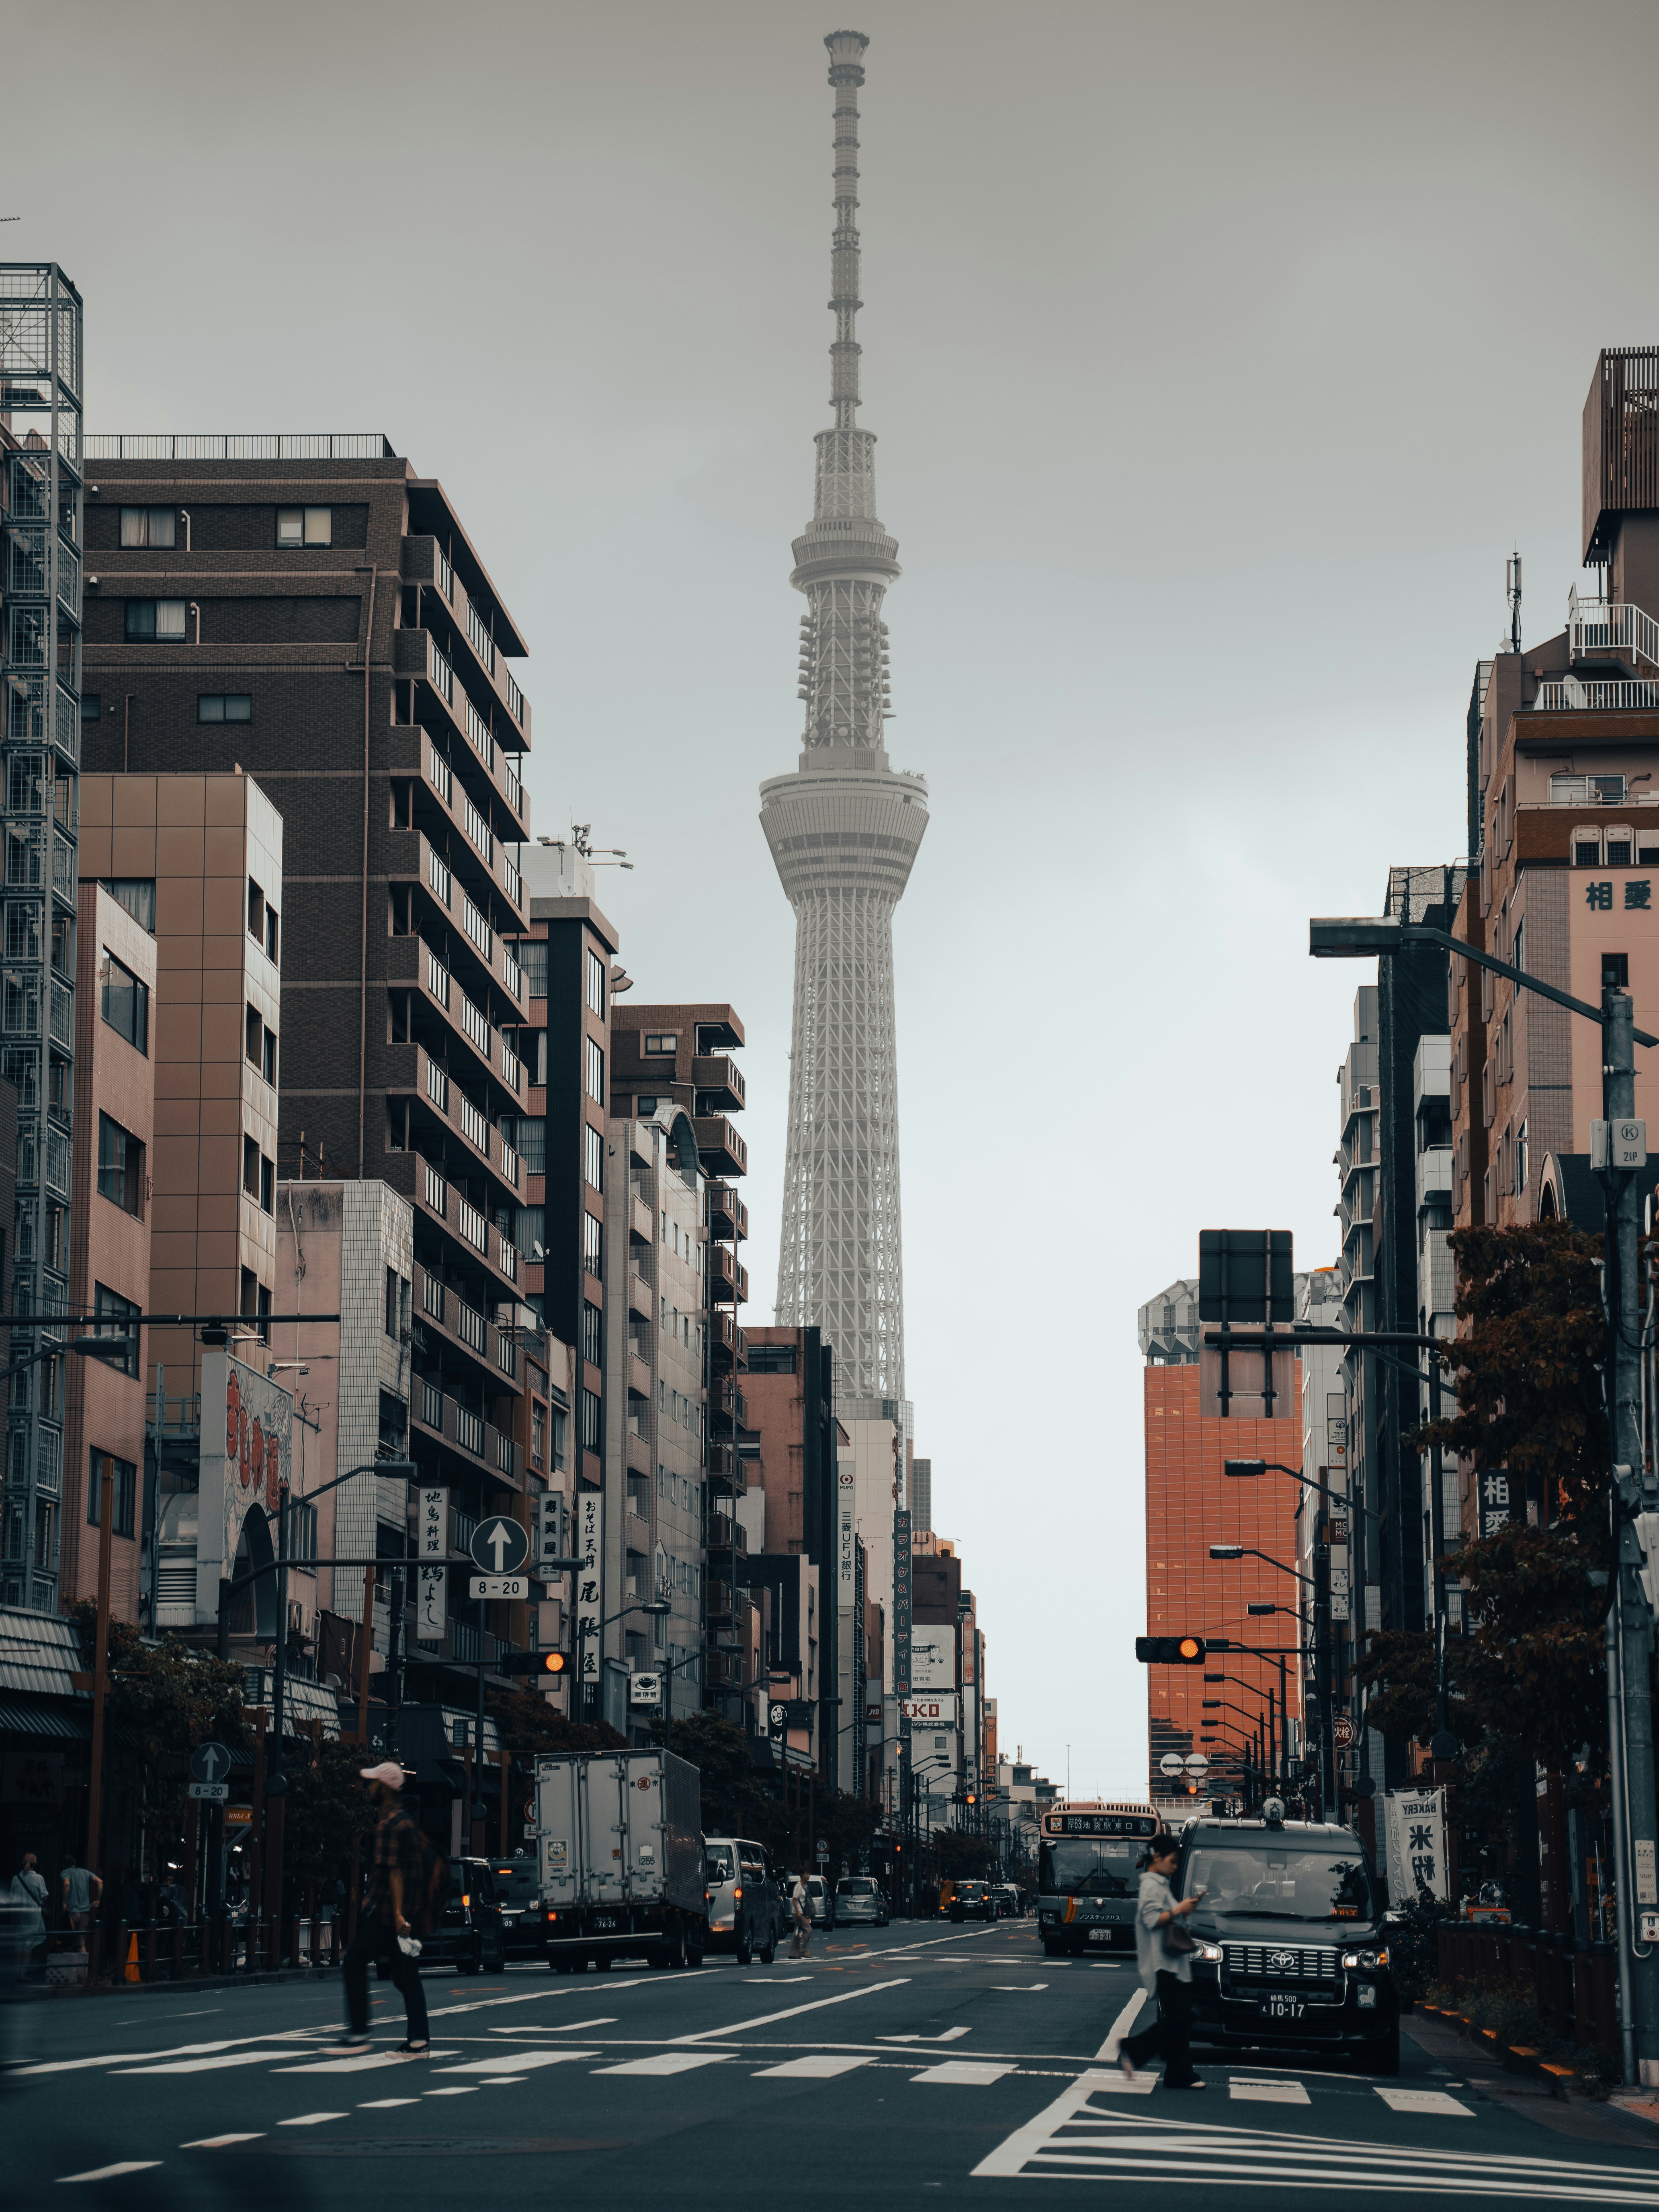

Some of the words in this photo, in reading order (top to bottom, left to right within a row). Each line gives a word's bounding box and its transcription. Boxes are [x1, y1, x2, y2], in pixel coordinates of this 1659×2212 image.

[1586, 880, 1651, 911] 相愛
[227, 1369, 289, 1523] すしや通
[842, 1512, 851, 1581] 三菱UFJ銀行
[1270, 1802, 1280, 1819] 大和
[639, 1858, 655, 1866] 1255
[1271, 2003, 1305, 2017] 10-17
